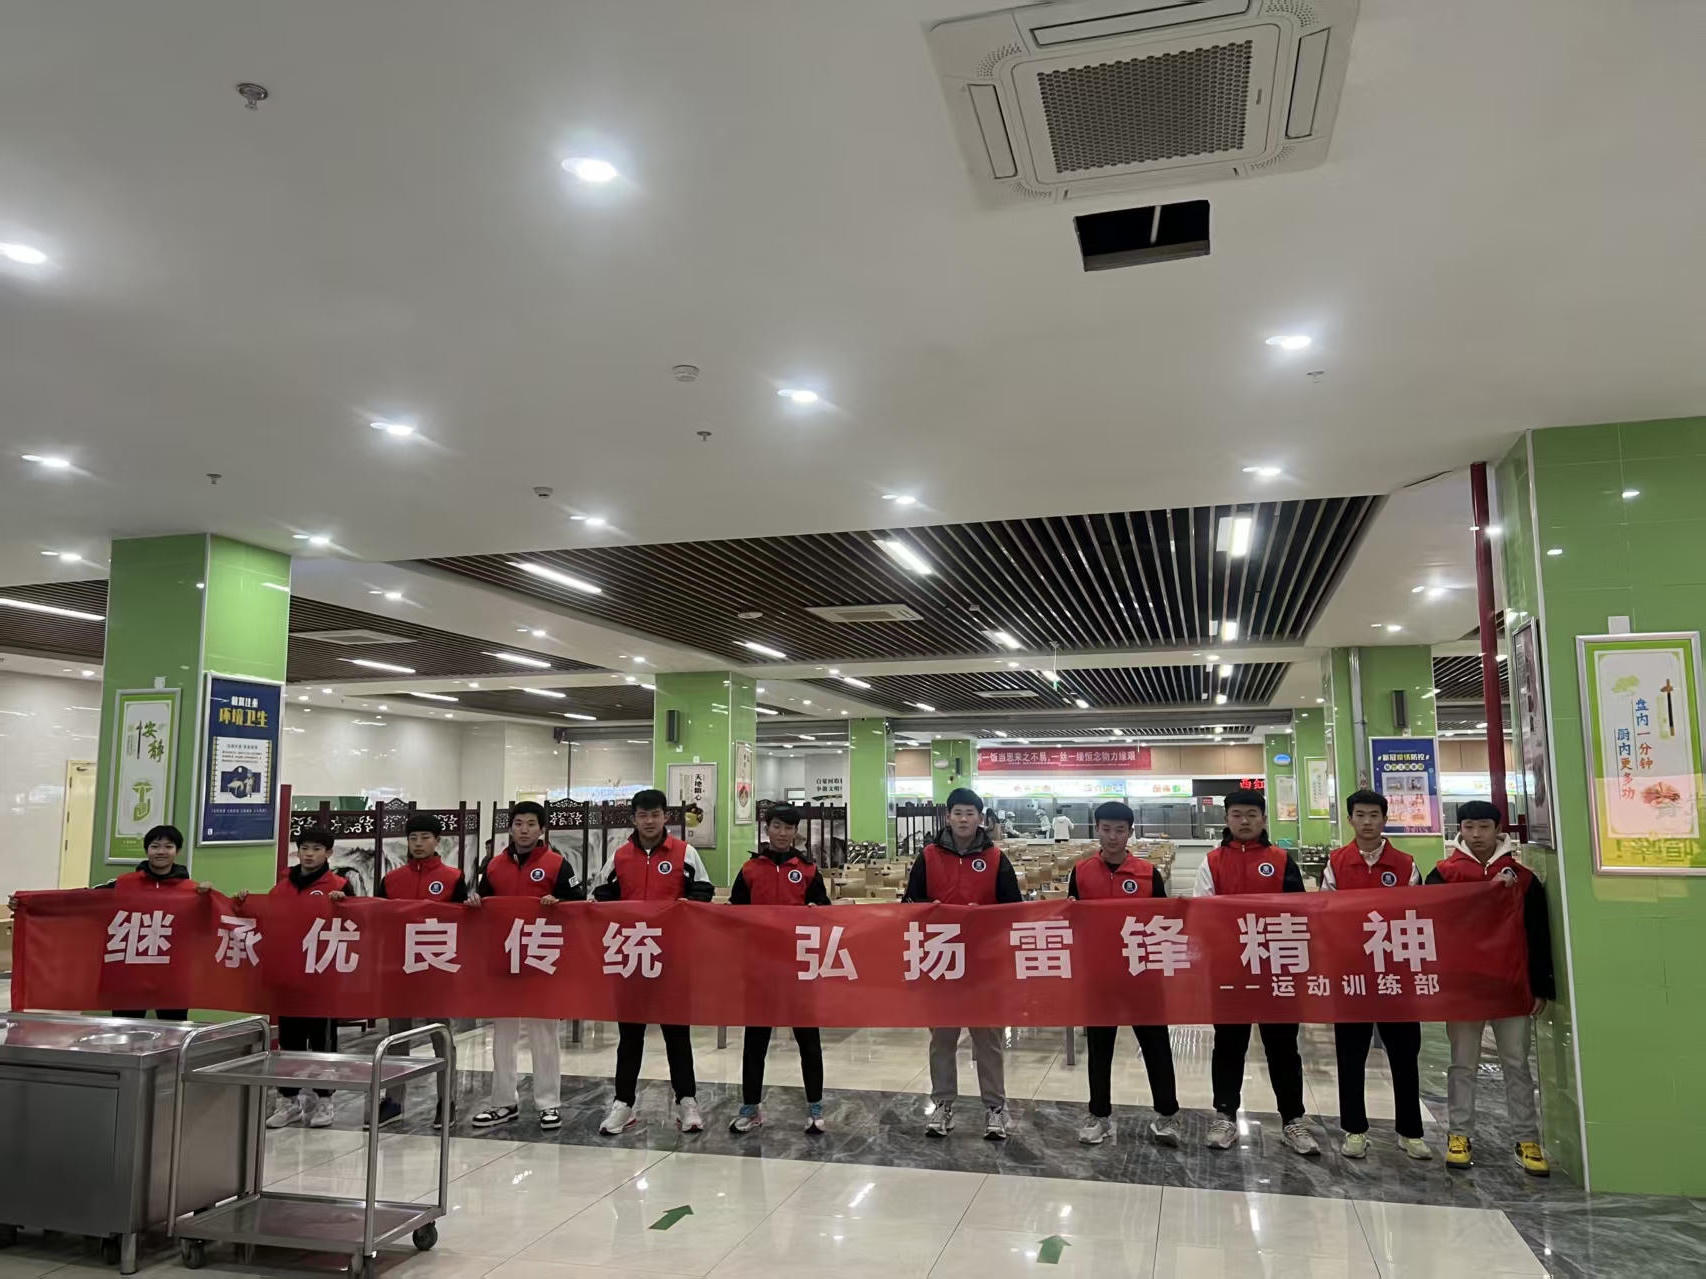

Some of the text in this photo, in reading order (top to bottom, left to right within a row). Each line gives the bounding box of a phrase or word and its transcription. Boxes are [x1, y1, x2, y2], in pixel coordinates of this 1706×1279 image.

[142, 720, 165, 763] 安静
[1616, 727, 1636, 801] 厨内更多功
[1634, 698, 1654, 770] 盘内一分钟
[104, 909, 1438, 982] 继承优良传统 弘扬雷锋精神
